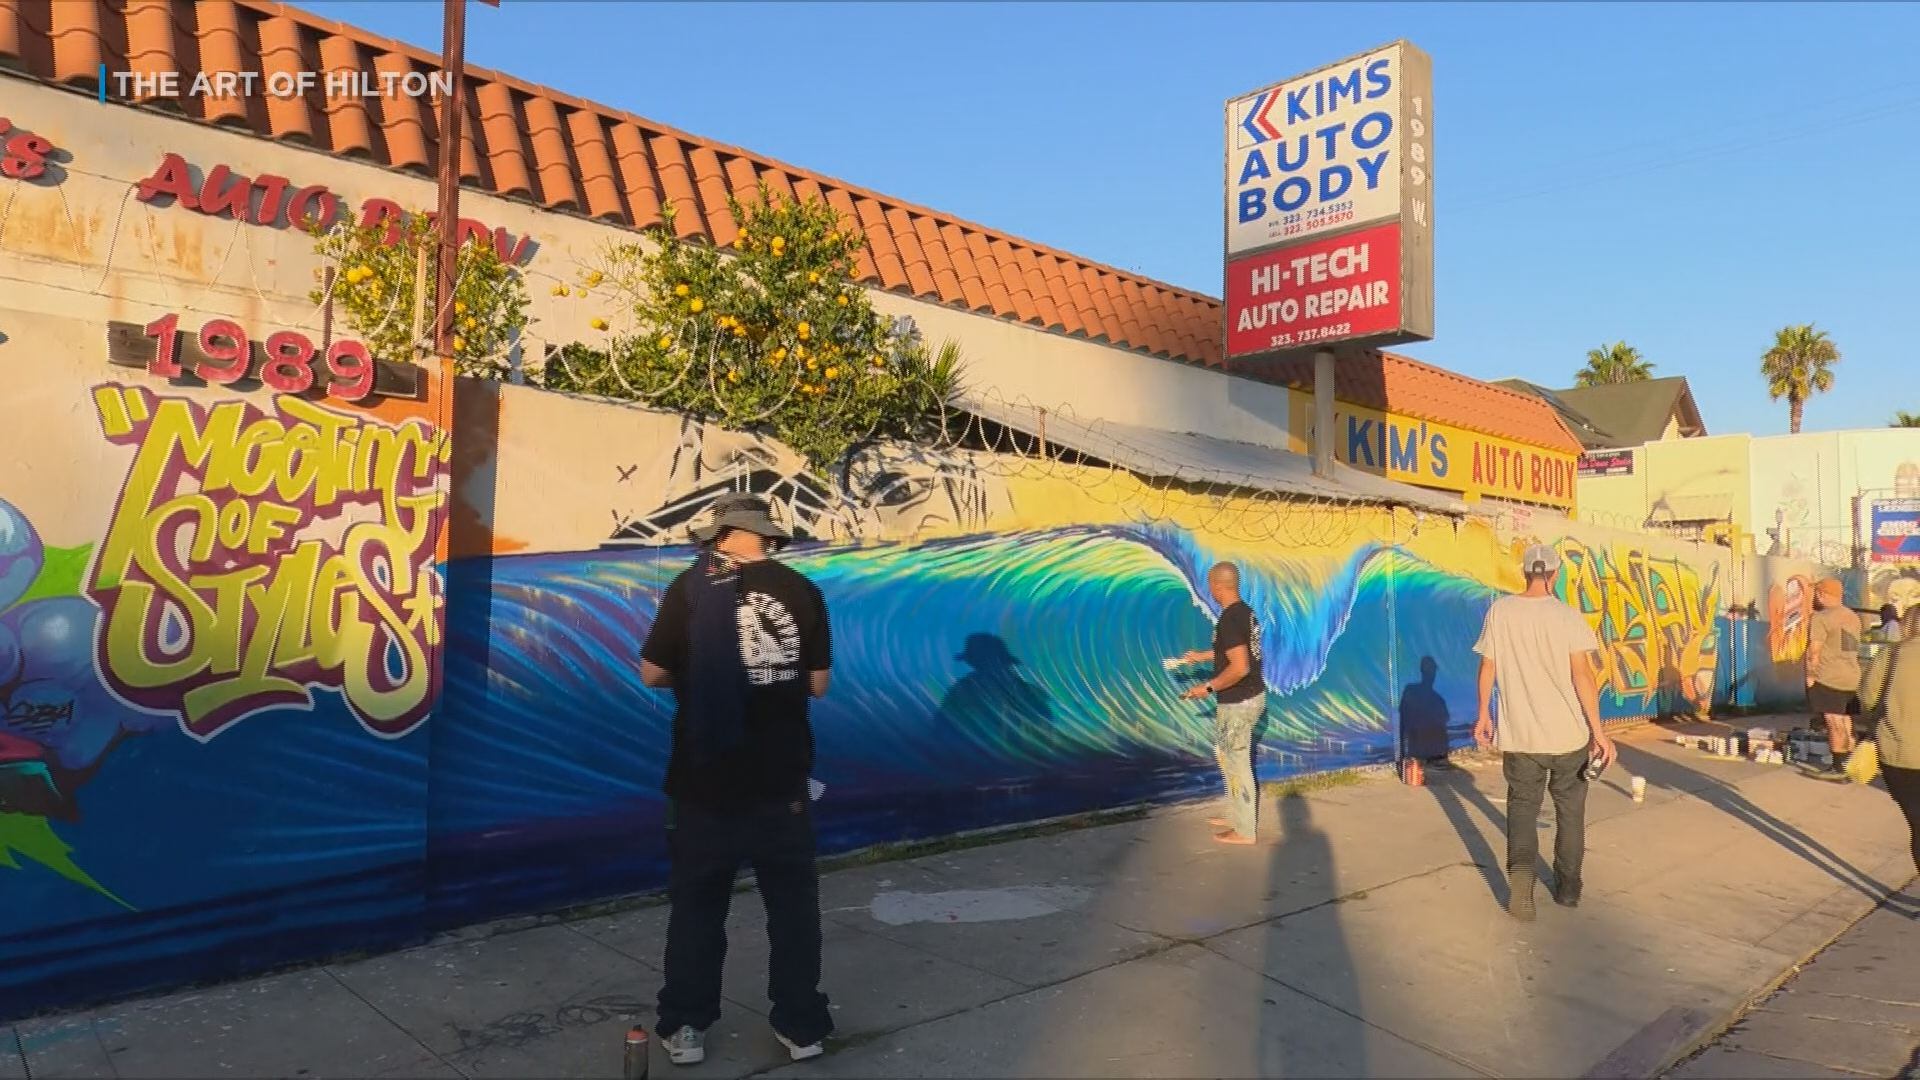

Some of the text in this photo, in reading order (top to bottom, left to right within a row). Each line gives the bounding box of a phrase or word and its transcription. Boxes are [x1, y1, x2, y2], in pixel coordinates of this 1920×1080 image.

[1287, 57, 1392, 126] KIM'S
[1238, 111, 1394, 187] AUTO
[136, 152, 339, 232] AUTO
[360, 198, 532, 266] BDY
[1238, 150, 1391, 225] BODY
[1237, 279, 1391, 333] AUTO REPAIR
[1251, 242, 1370, 297] HI-TECH
[144, 312, 377, 401] 1989
[1347, 414, 1576, 500] KIM'S AUTO BODY
[216, 497, 302, 555] OF
